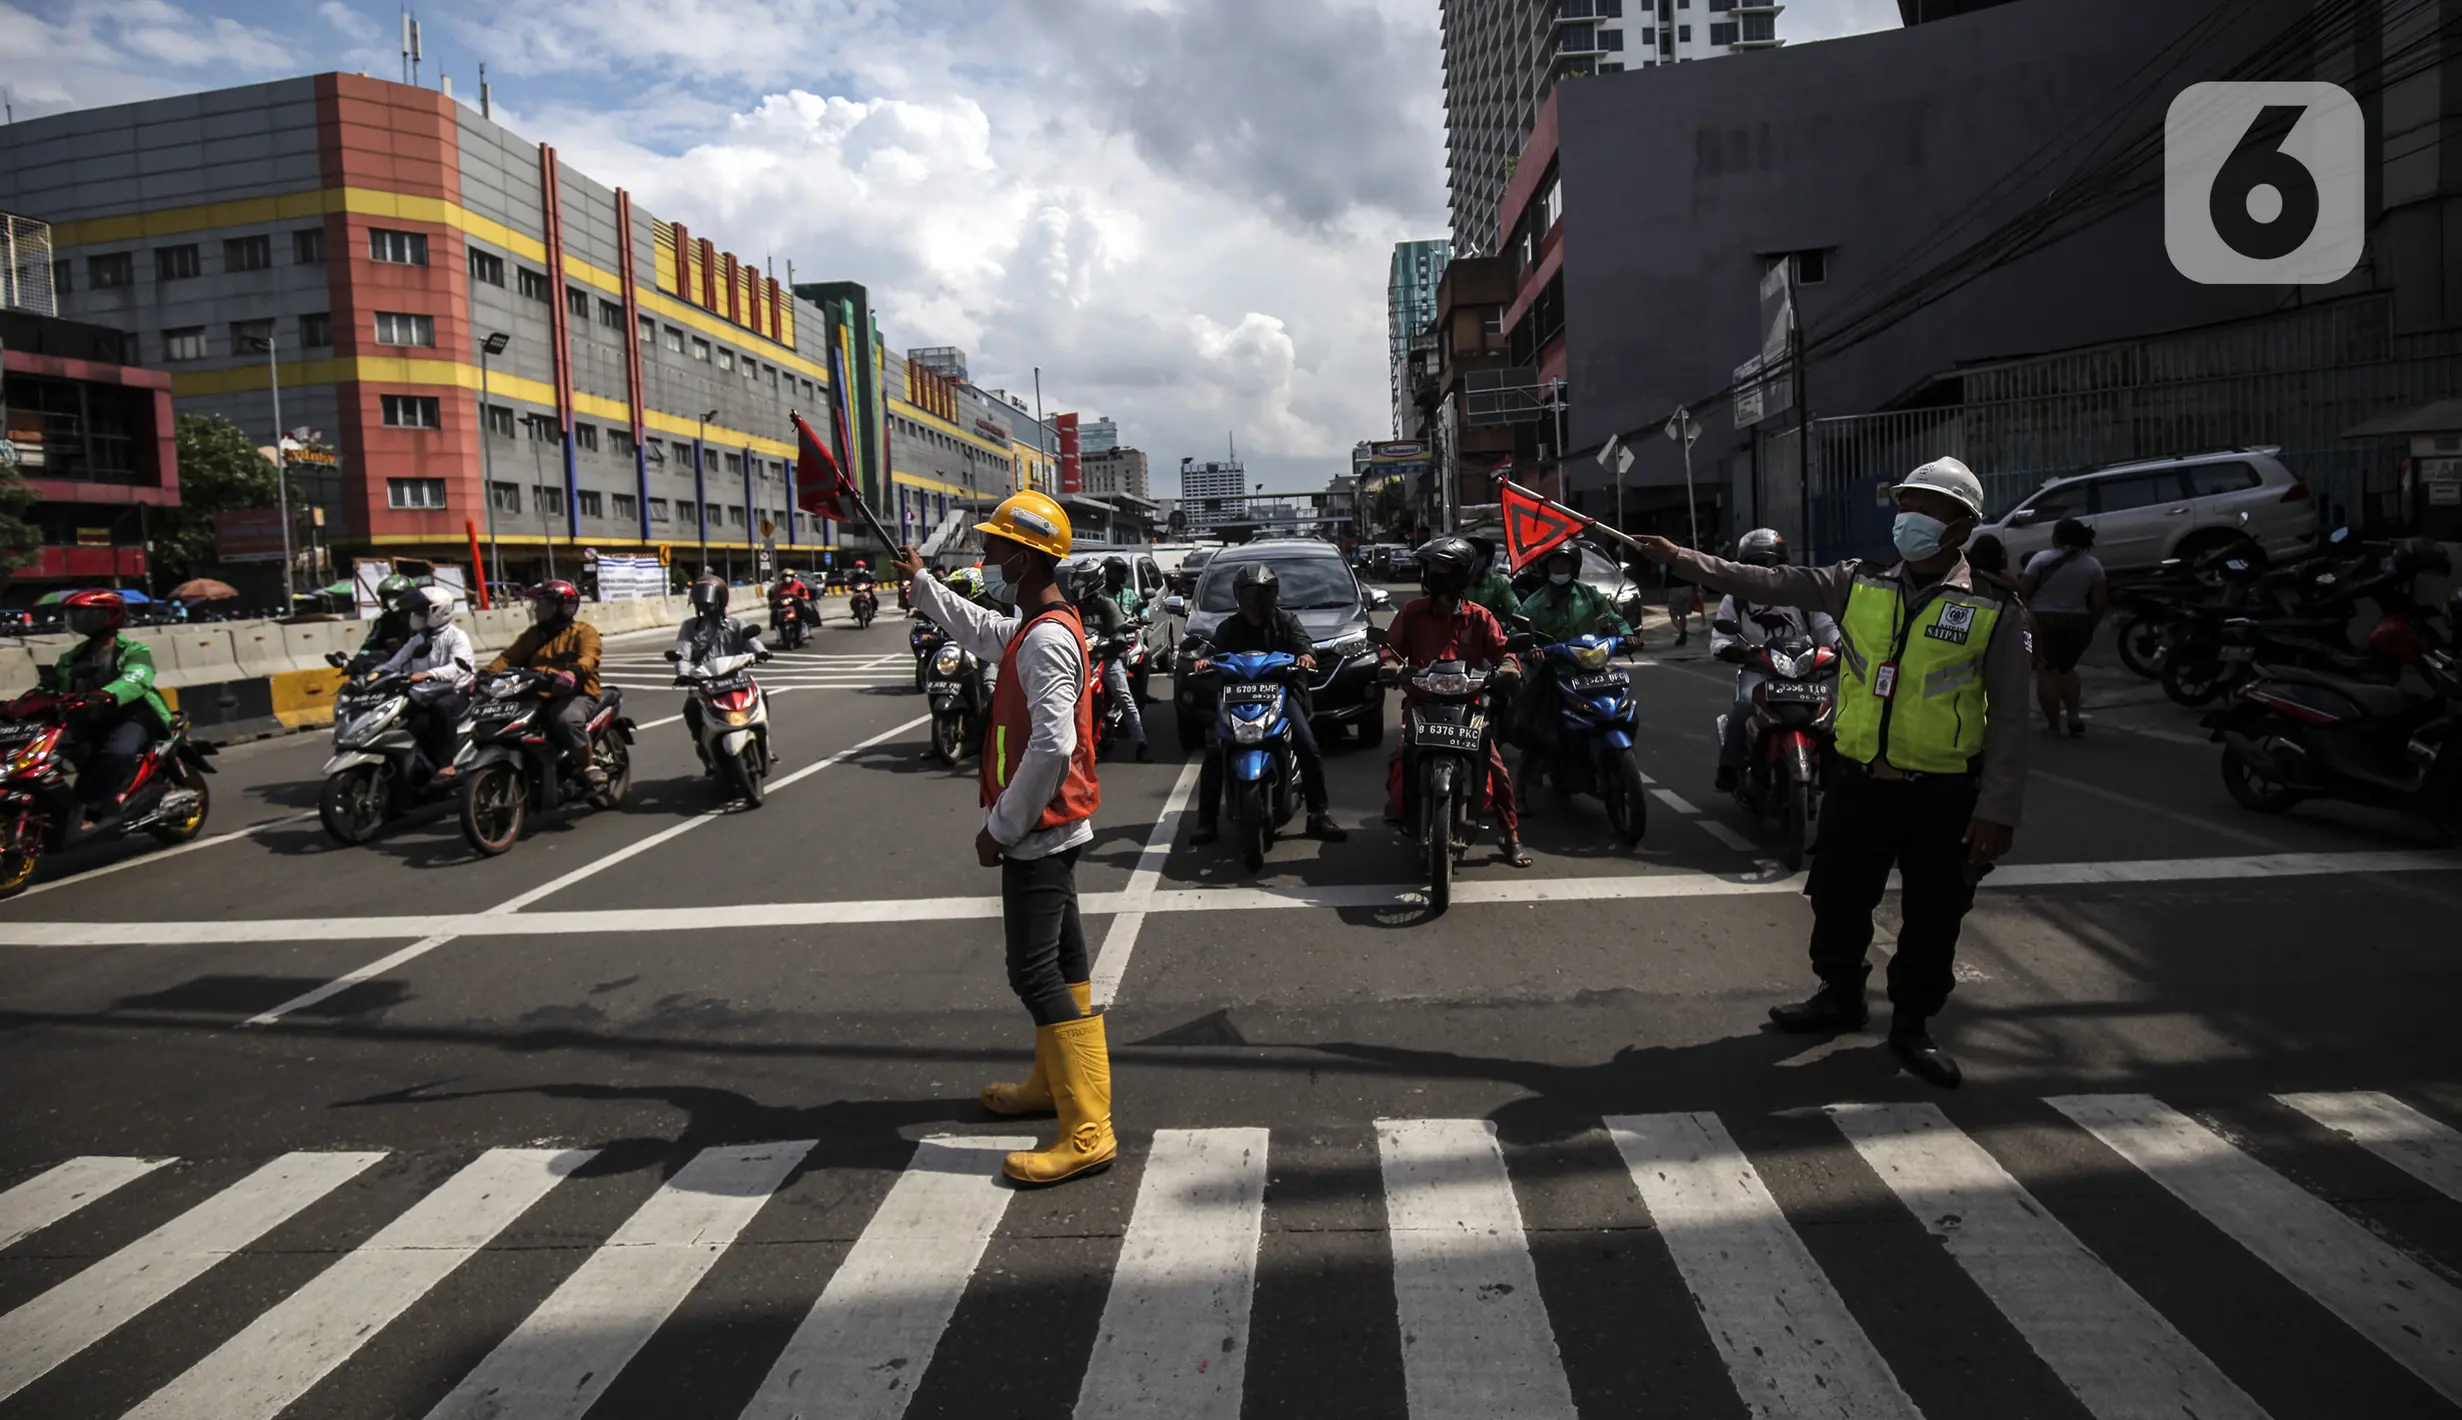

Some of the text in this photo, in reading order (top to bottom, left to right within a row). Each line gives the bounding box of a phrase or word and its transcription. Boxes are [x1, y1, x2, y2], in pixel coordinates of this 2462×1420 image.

[1927, 626, 1966, 643] SATPAM
[1226, 686, 1232, 694] B
[1236, 685, 1257, 694] 6709
[1419, 725, 1479, 740] B 6376 PKC
